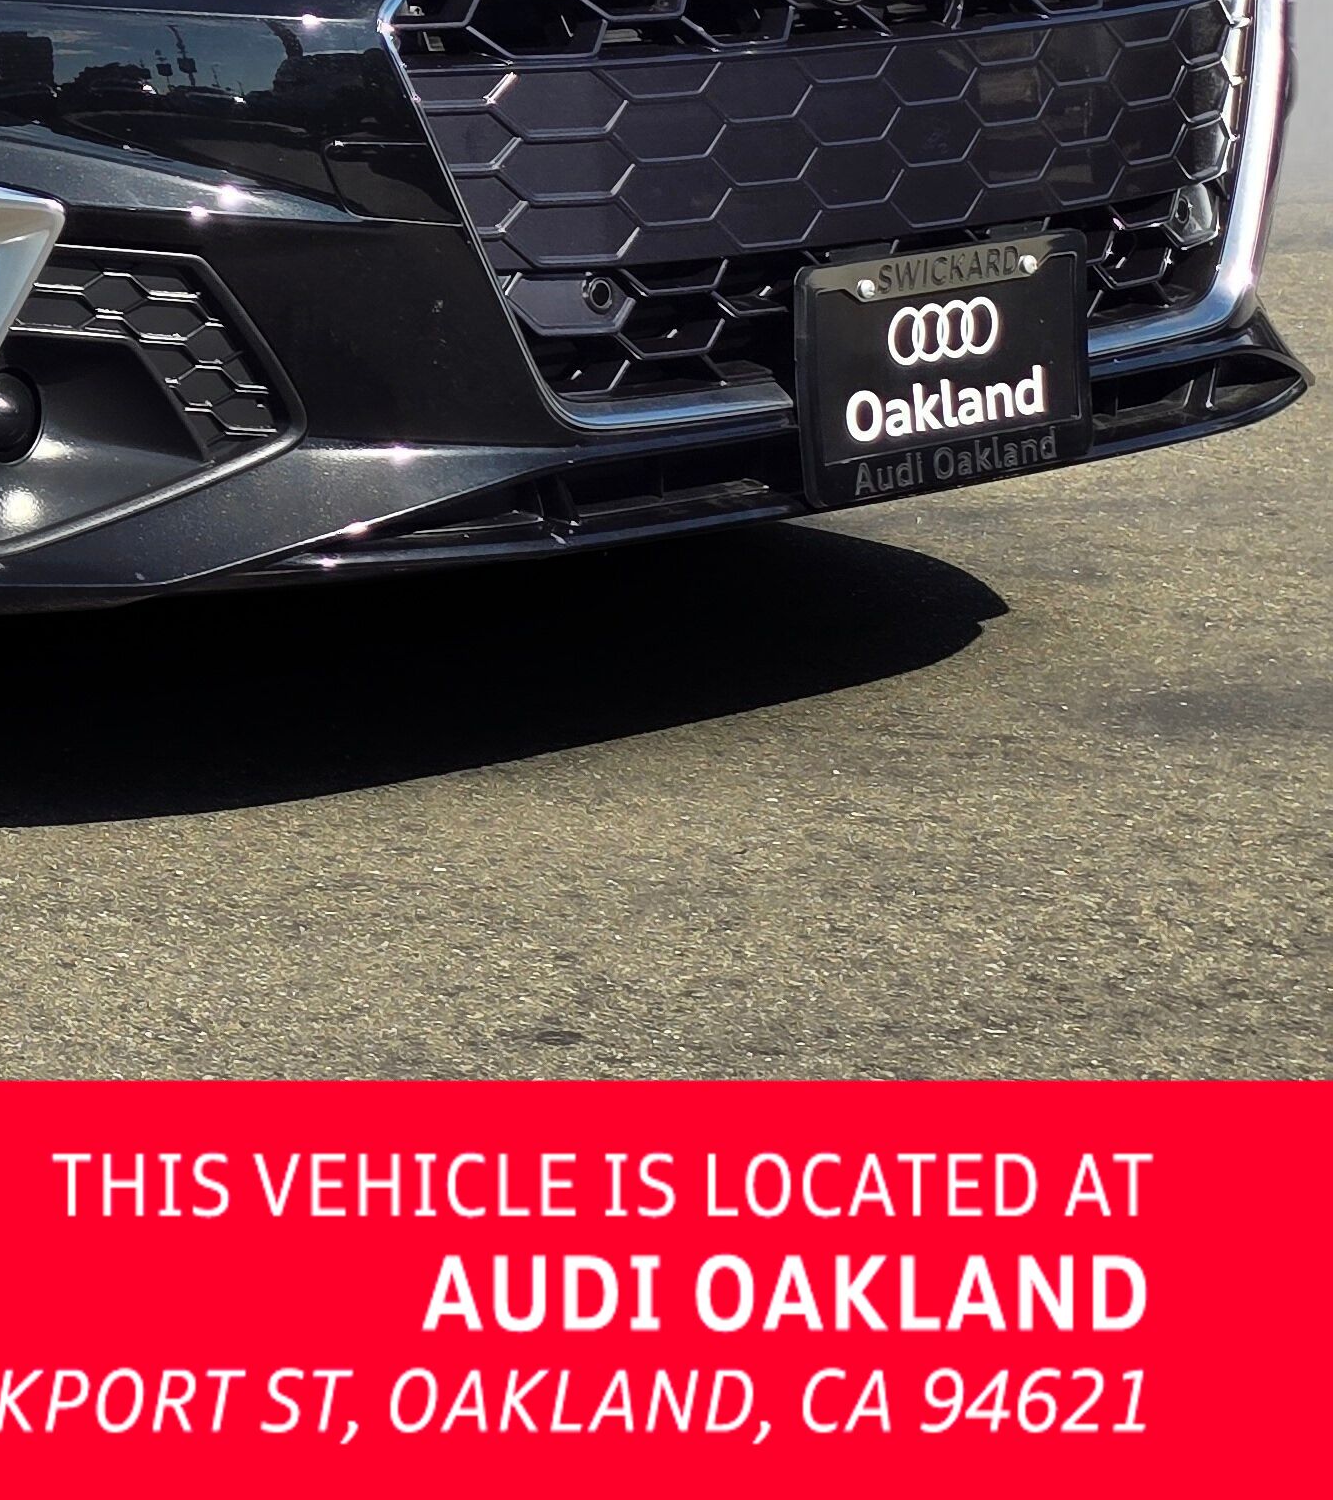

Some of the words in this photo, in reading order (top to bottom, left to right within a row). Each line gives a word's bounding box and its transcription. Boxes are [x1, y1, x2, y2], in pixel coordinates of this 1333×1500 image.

[877, 245, 1020, 295] SWICKARD
[845, 364, 1046, 442] Oakland
[854, 450, 924, 496] Audi
[933, 426, 1058, 481] Oakland
